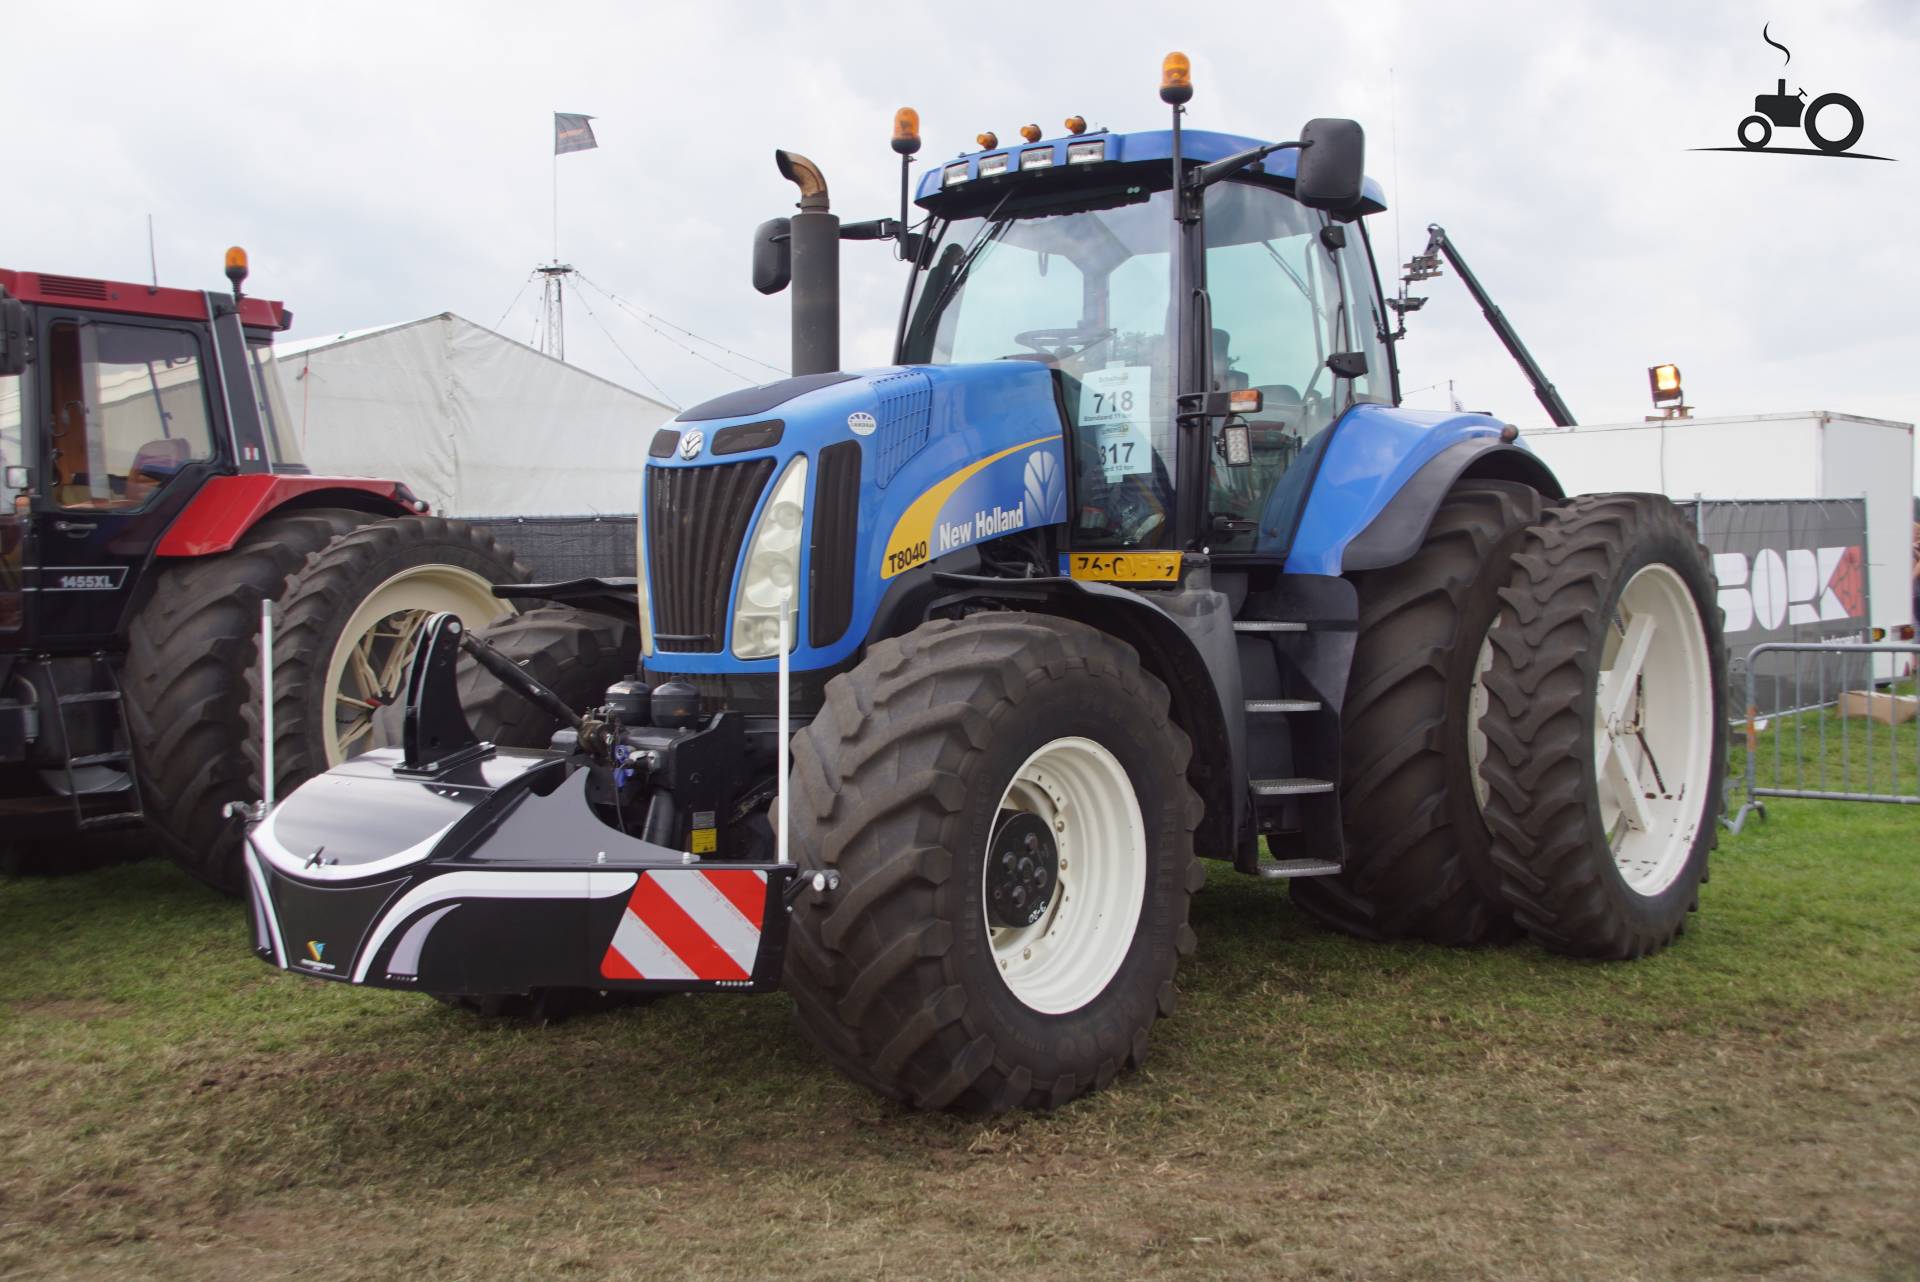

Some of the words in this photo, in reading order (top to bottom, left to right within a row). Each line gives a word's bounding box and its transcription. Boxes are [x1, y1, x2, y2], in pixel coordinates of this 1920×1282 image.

[1093, 390, 1134, 414] 718
[939, 520, 973, 551] New
[975, 501, 1024, 539] Holland
[888, 540, 927, 573] T8040
[60, 575, 114, 588] 1455XL
[1713, 547, 1850, 633] BORK
